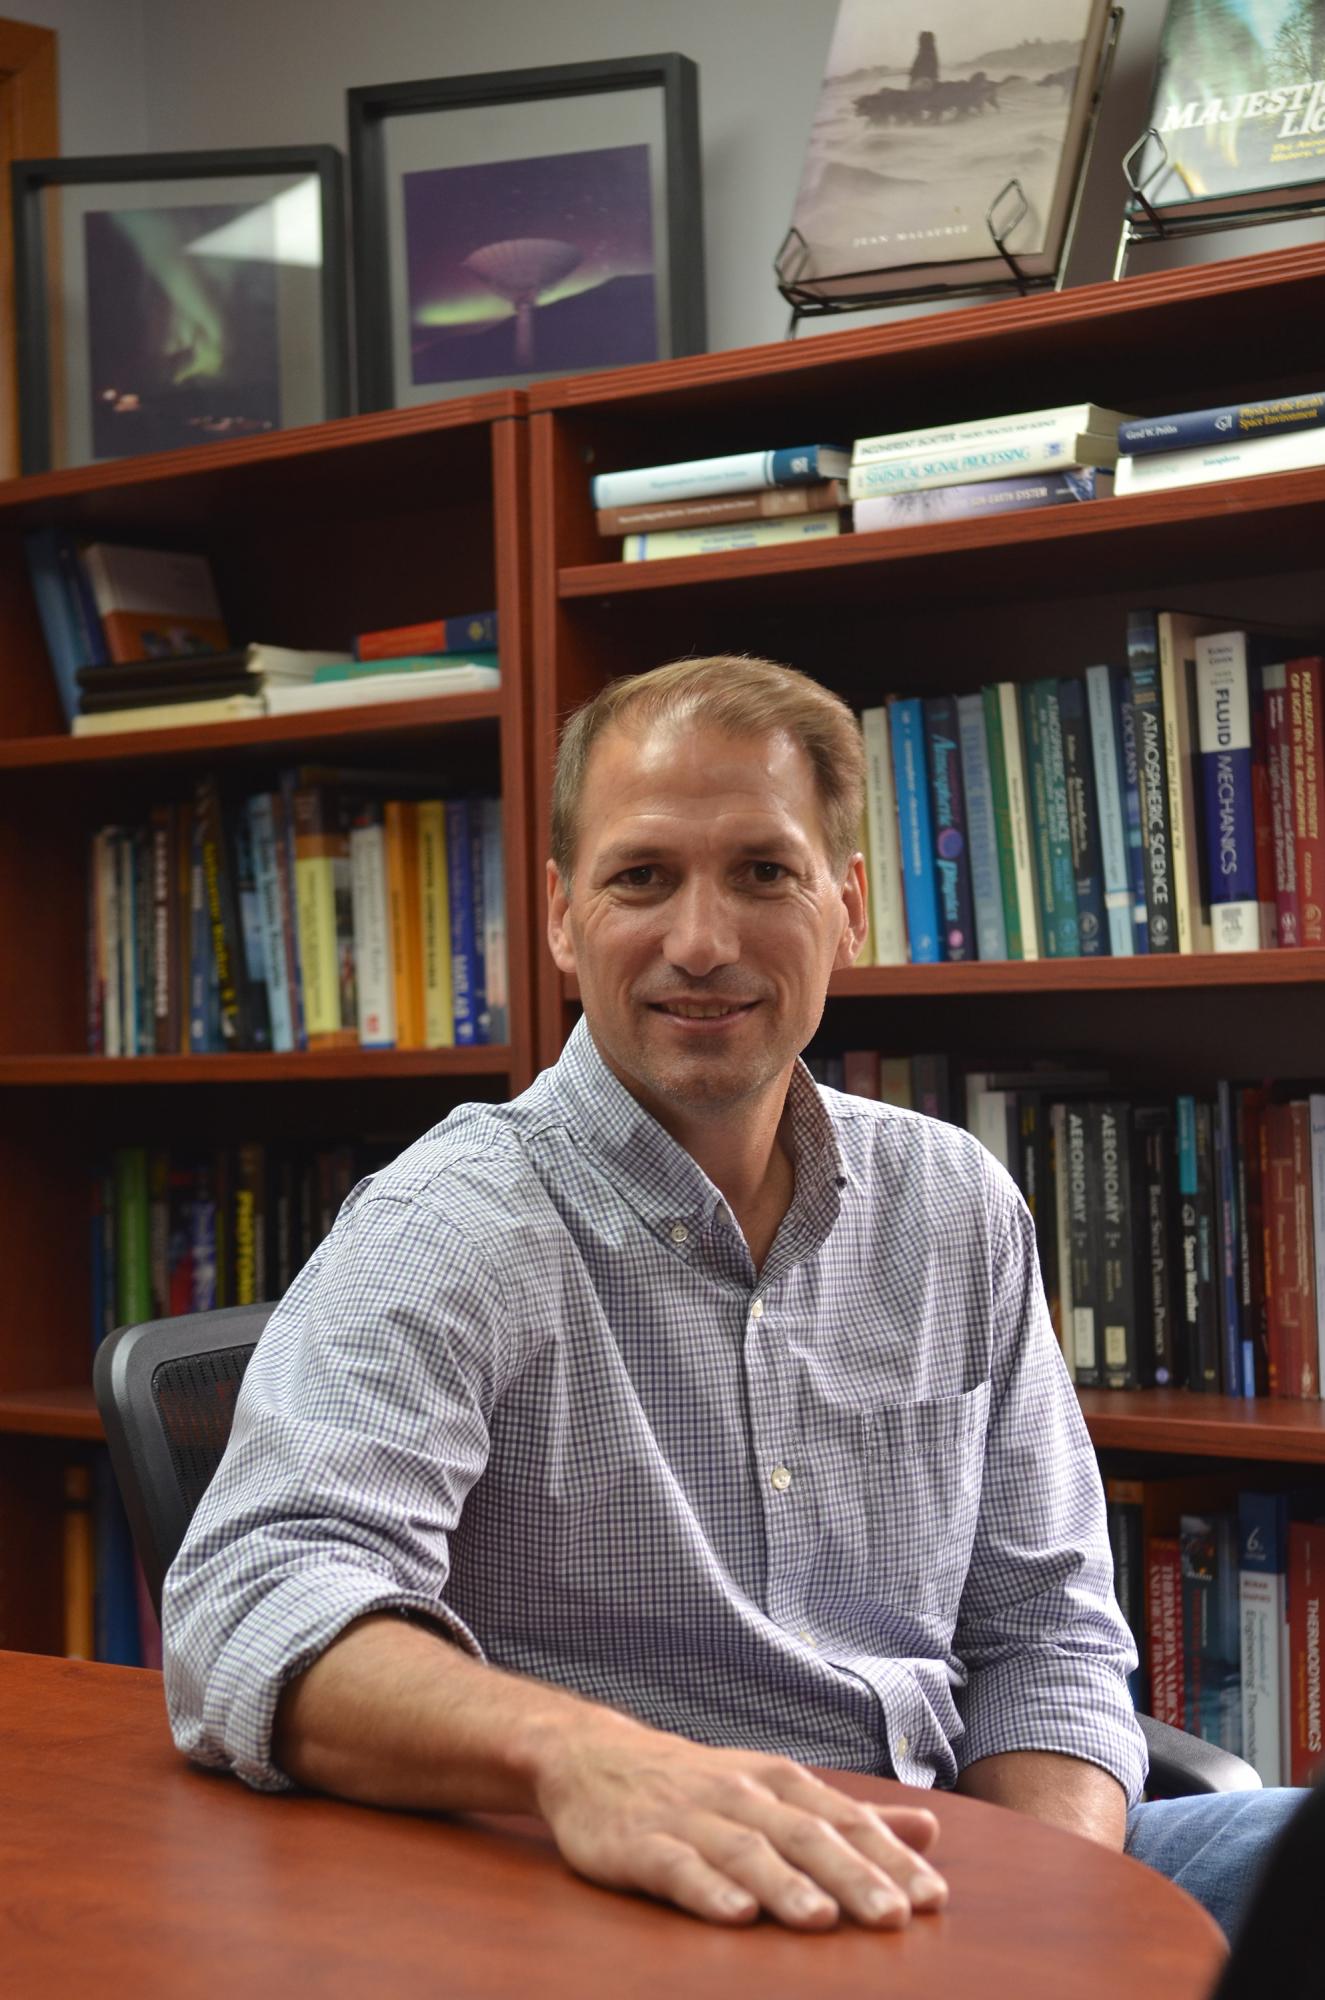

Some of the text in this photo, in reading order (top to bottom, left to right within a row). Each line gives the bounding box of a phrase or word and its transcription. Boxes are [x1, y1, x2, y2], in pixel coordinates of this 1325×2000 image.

[1056, 787, 1071, 843] SCIENCE
[1143, 711, 1164, 830] ATMOSPHERIC
[1216, 687, 1238, 875] FLUID MECHANICS
[1150, 833, 1168, 904] SCIENCE
[1070, 1113, 1087, 1223] AERONOMY
[1102, 1112, 1120, 1224] AERONOMY
[1183, 1233, 1199, 1322] Space Weather
[1307, 1596, 1321, 1752] THERMODYNAMICS
